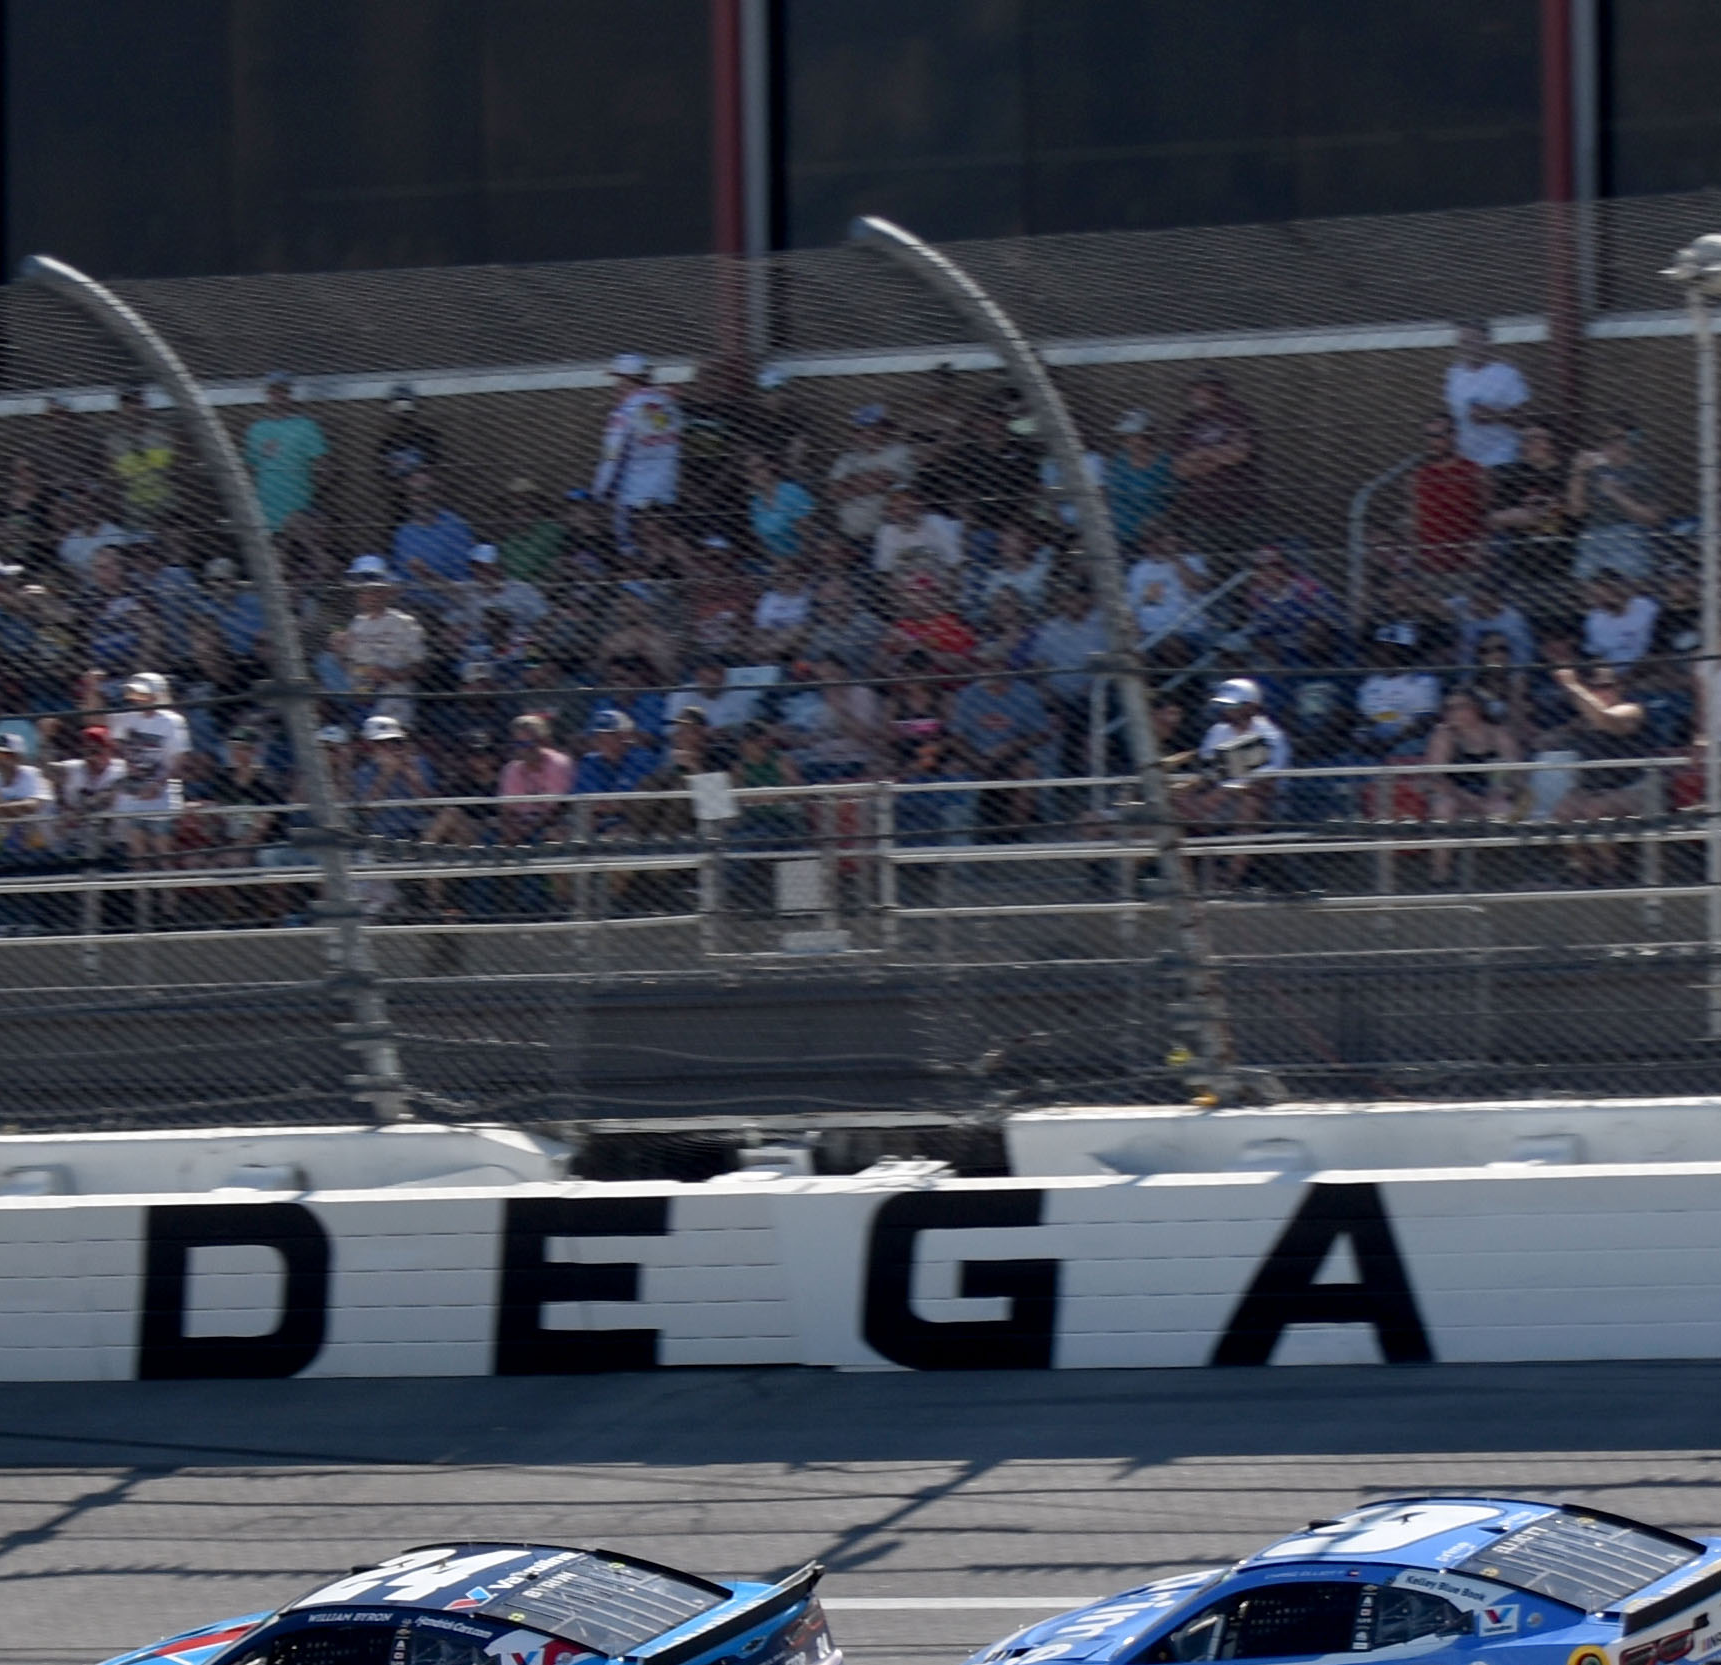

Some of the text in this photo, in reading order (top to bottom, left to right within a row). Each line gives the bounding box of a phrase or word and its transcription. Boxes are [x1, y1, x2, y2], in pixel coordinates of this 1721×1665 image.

[1406, 1575, 1436, 1591] Kelley
[1439, 1582, 1459, 1595] Blue
[308, 1612, 394, 1623] WILLIAM BYRON
